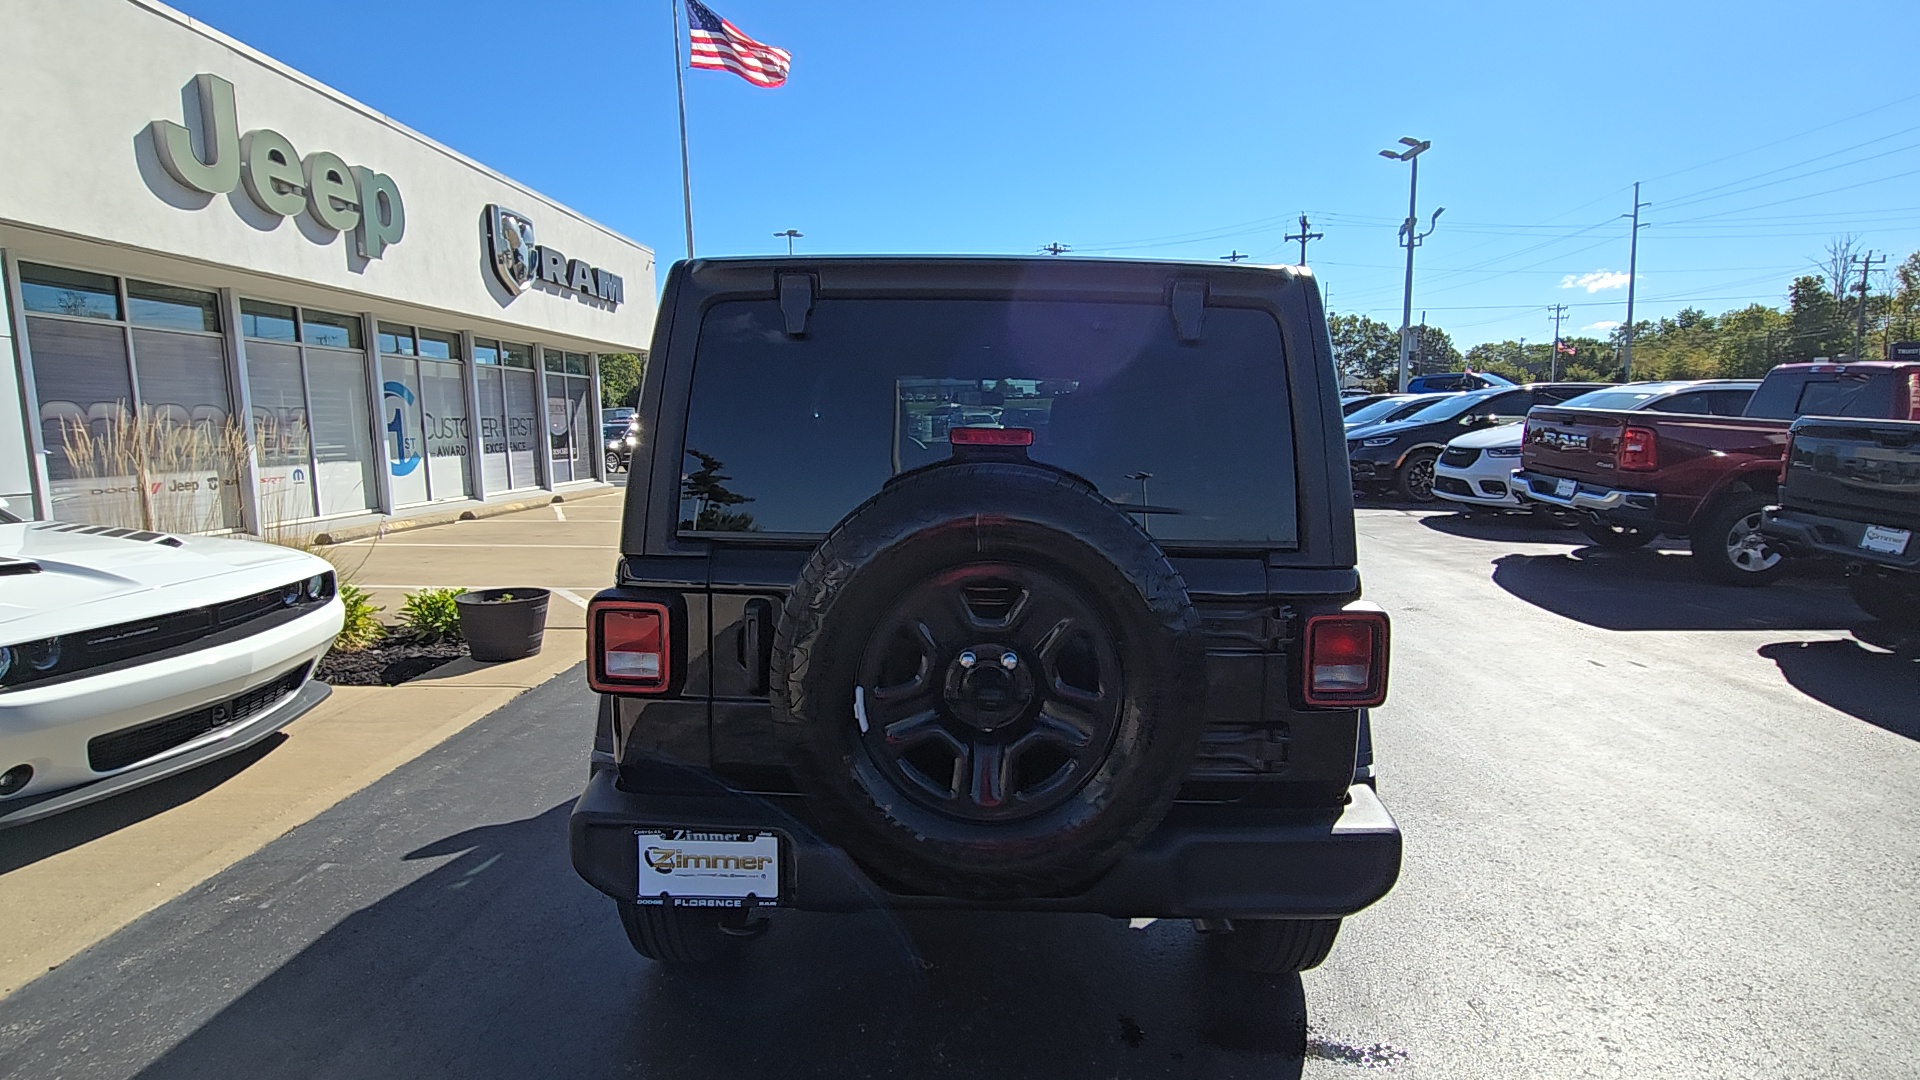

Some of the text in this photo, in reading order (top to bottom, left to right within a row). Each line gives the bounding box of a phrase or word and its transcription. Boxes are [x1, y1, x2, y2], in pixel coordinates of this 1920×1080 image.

[152, 73, 405, 260] Jeep
[536, 245, 624, 304] RAM
[425, 412, 500, 439] CUSTOER
[1542, 431, 1589, 448] RAM
[436, 441, 527, 457] AWARD EXCELENCE
[91, 485, 146, 495] DODG
[168, 479, 200, 493] Jeep
[672, 829, 741, 841] Zimmer
[652, 848, 773, 871] Zimmer
[674, 898, 742, 908] FLORENCE
